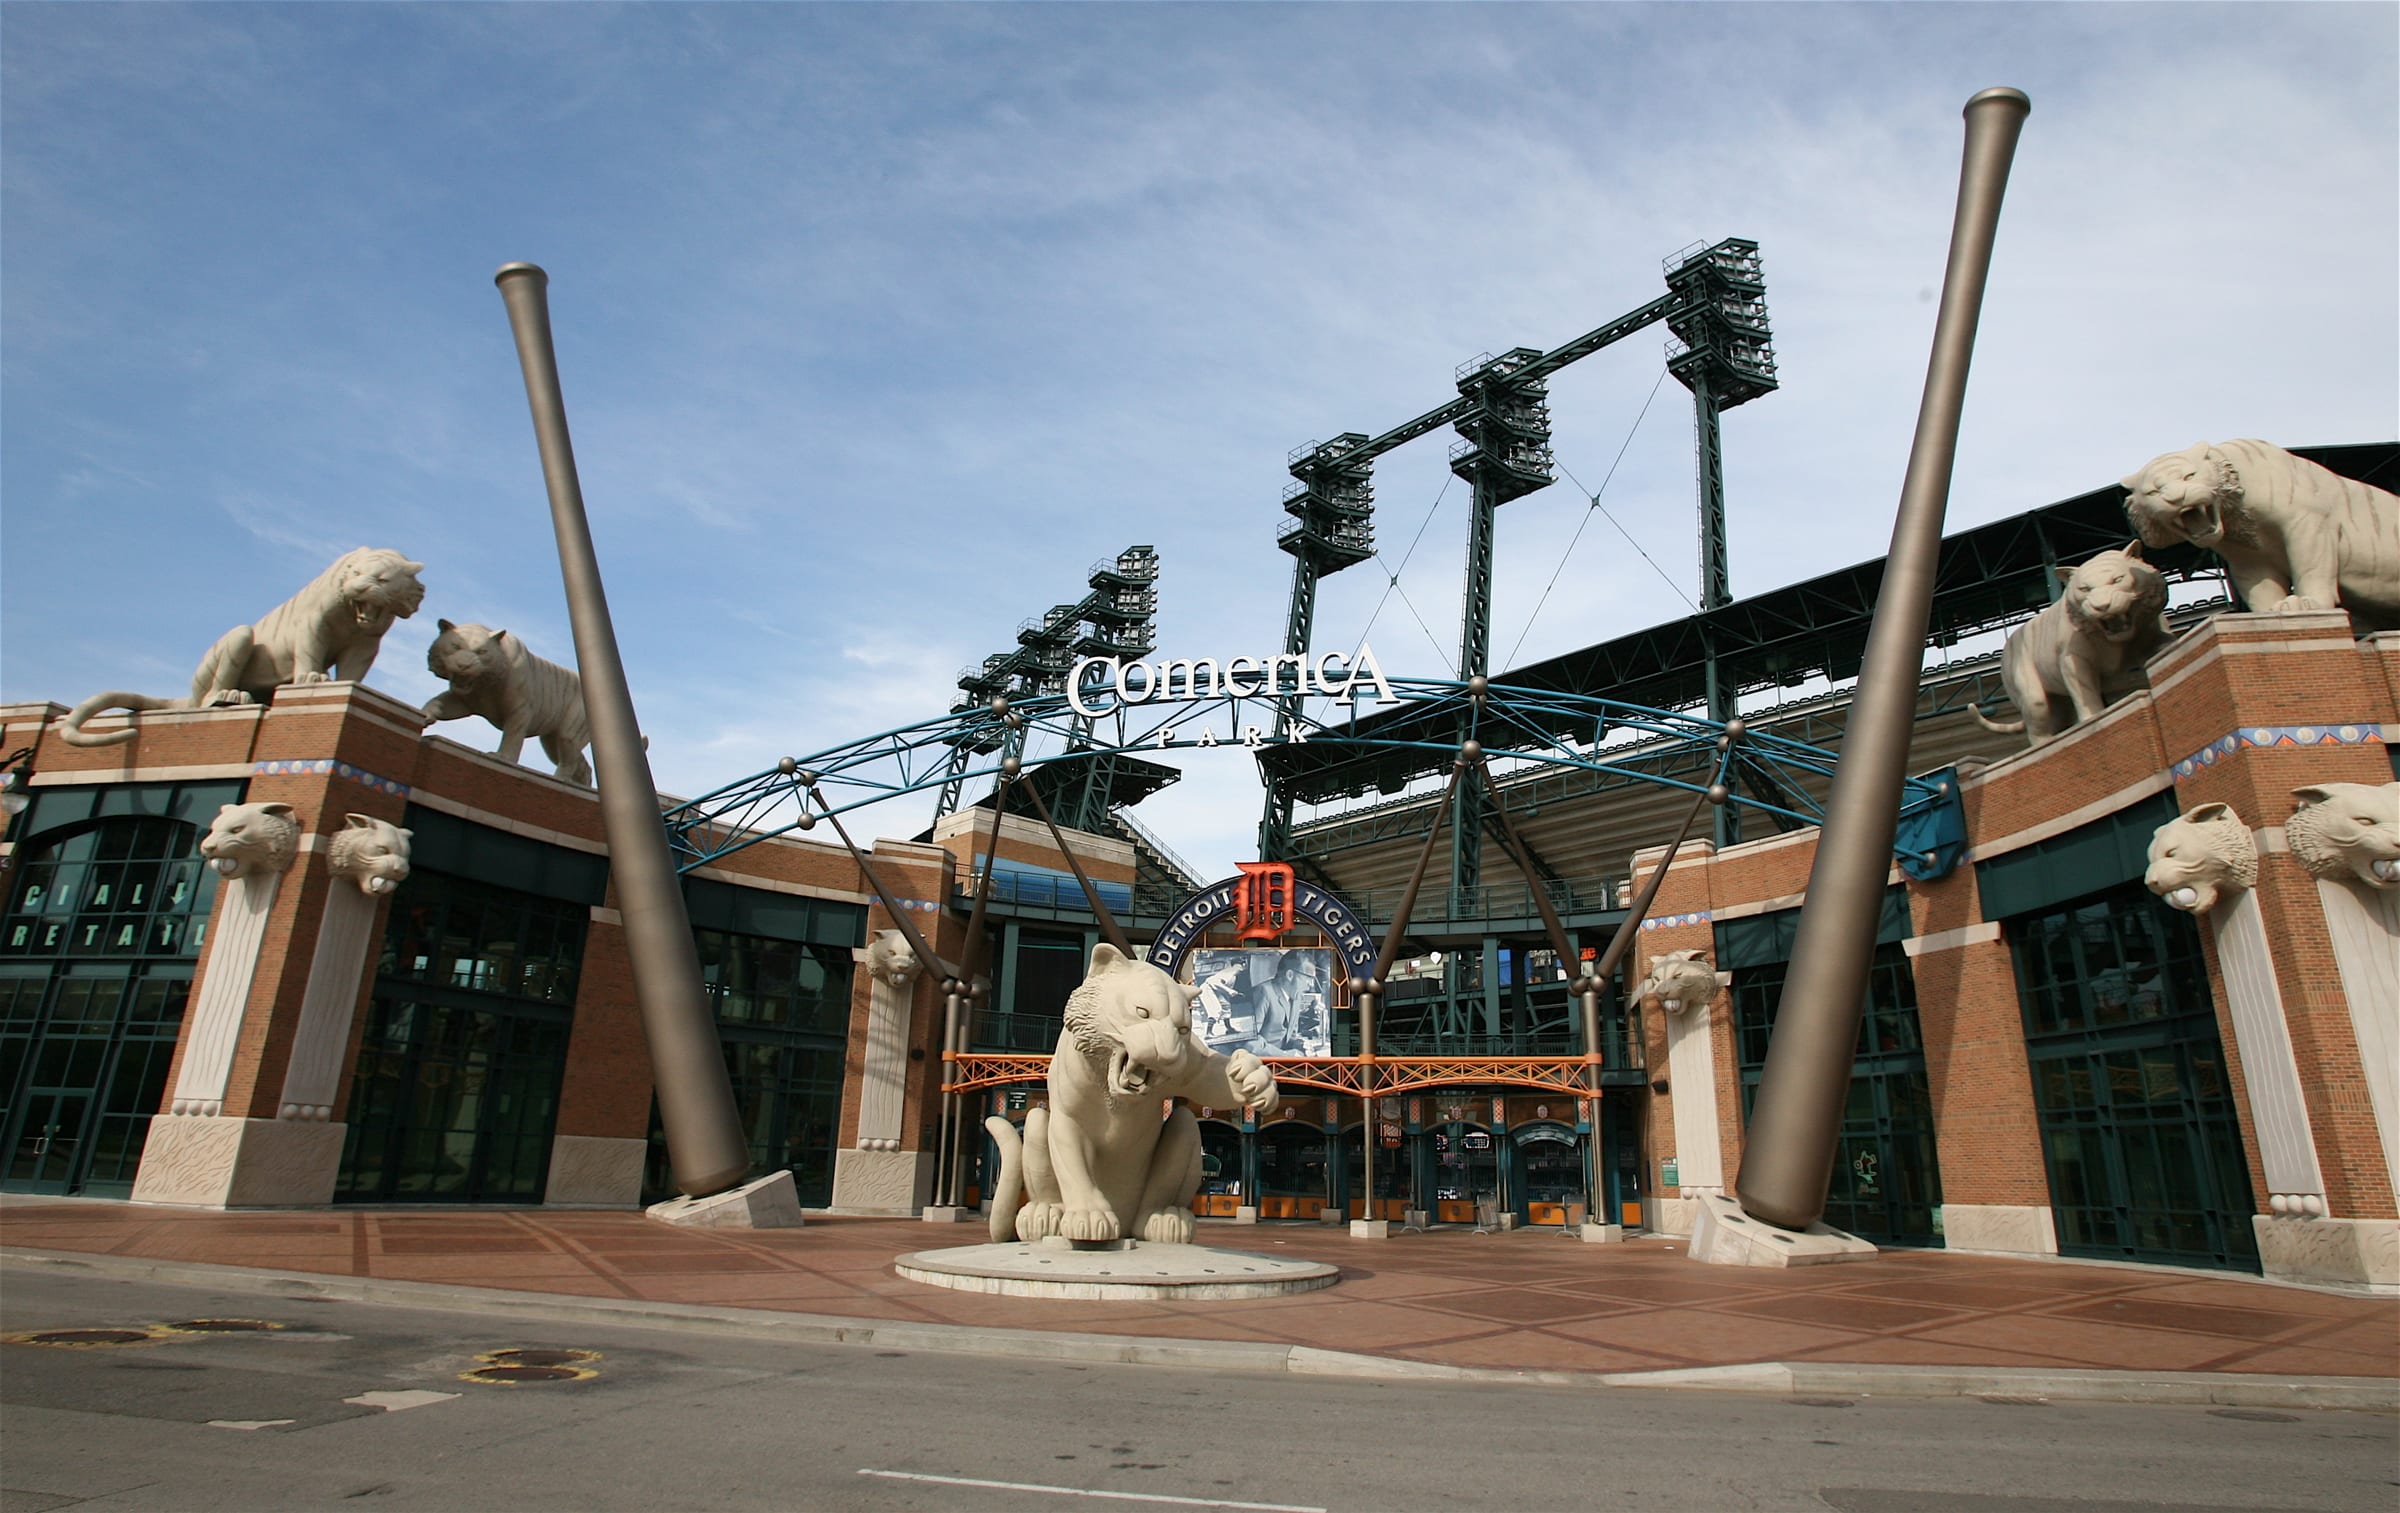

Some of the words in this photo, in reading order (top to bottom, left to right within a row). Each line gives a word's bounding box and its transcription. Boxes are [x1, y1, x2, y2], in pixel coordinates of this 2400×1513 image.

[1157, 722, 1309, 749] PARK
[23, 883, 144, 907] CIAL
[1234, 861, 1296, 941] D
[11, 924, 206, 947] RETAIL
[1154, 886, 1232, 968] DETROIT
[1299, 891, 1371, 966] TIGERS
